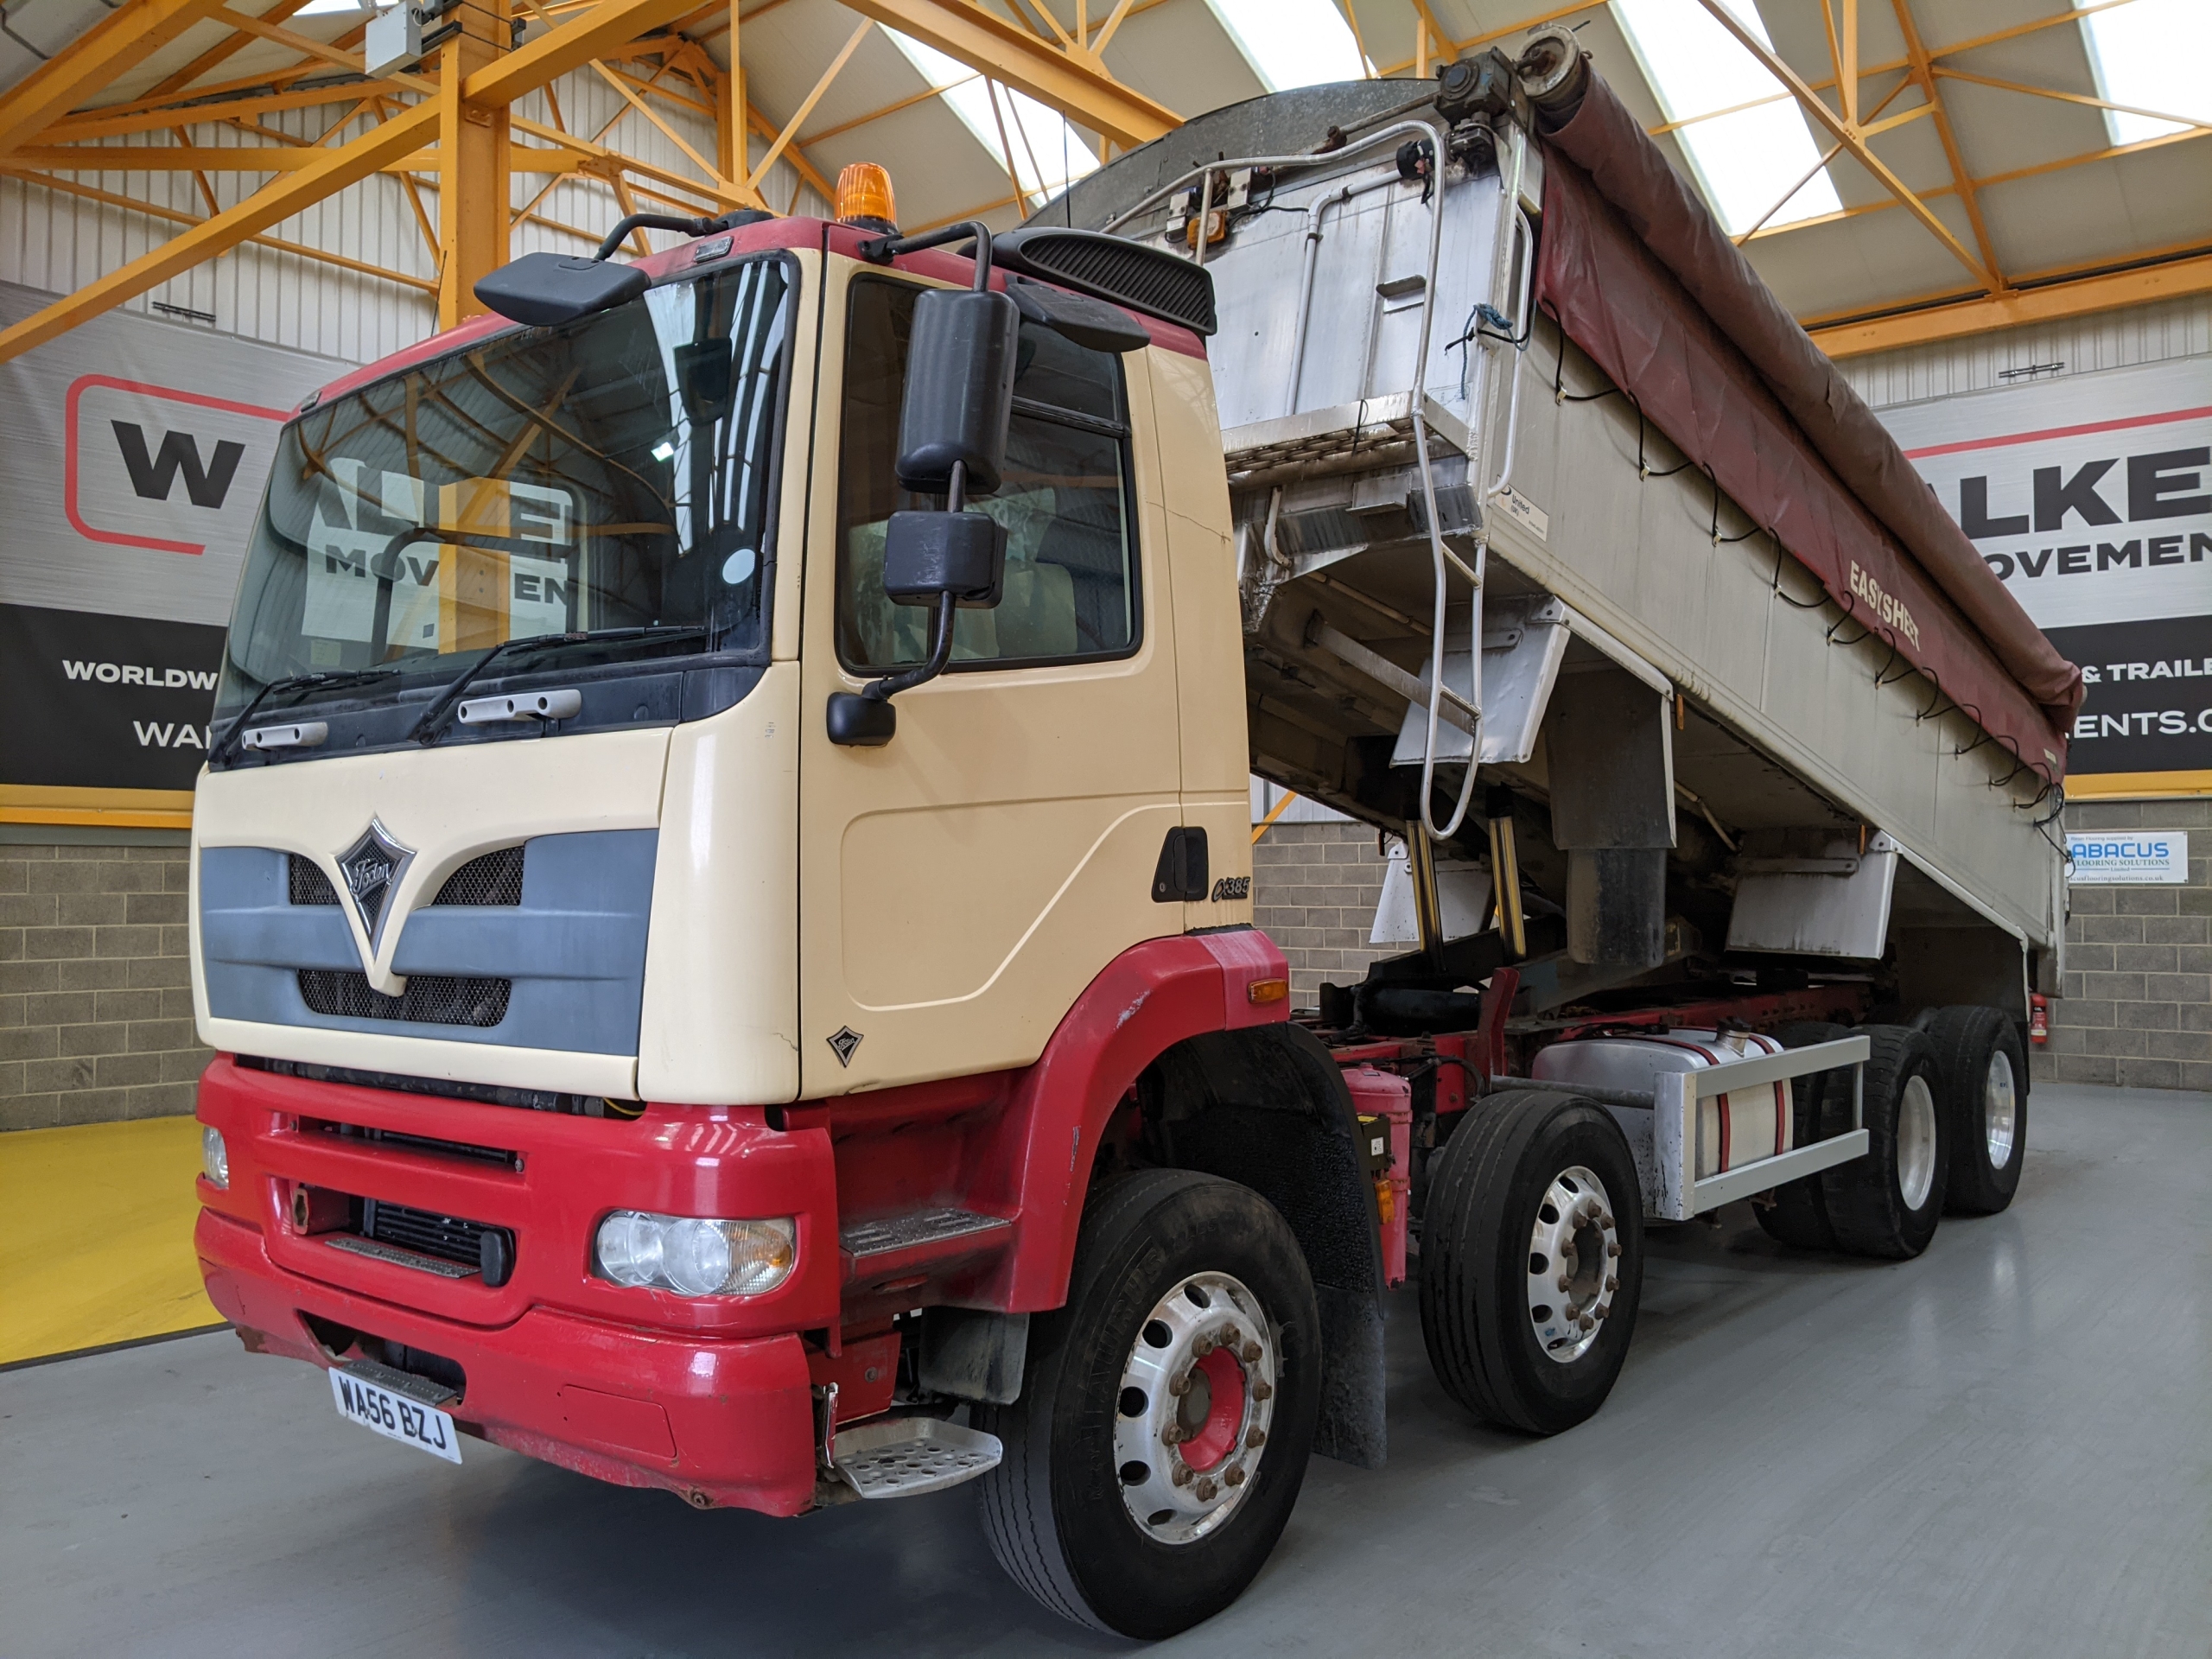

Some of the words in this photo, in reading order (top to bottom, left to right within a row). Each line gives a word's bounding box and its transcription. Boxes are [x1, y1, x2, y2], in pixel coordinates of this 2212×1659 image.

[1511, 493, 1529, 515] United
[1983, 532, 2212, 581] OVEMEN
[1850, 559, 1920, 652] EASYSHEET
[62, 659, 219, 690] WORLDW
[2081, 665, 2102, 683] &
[2072, 842, 2170, 858] ABACUS
[2119, 858, 2170, 867] SOLUTIONS
[350, 859, 391, 894] Foden
[2069, 874, 2164, 883] acusflooringsolutions.co.uk
[338, 1376, 396, 1430] WA56
[397, 1400, 447, 1450] BZJ
